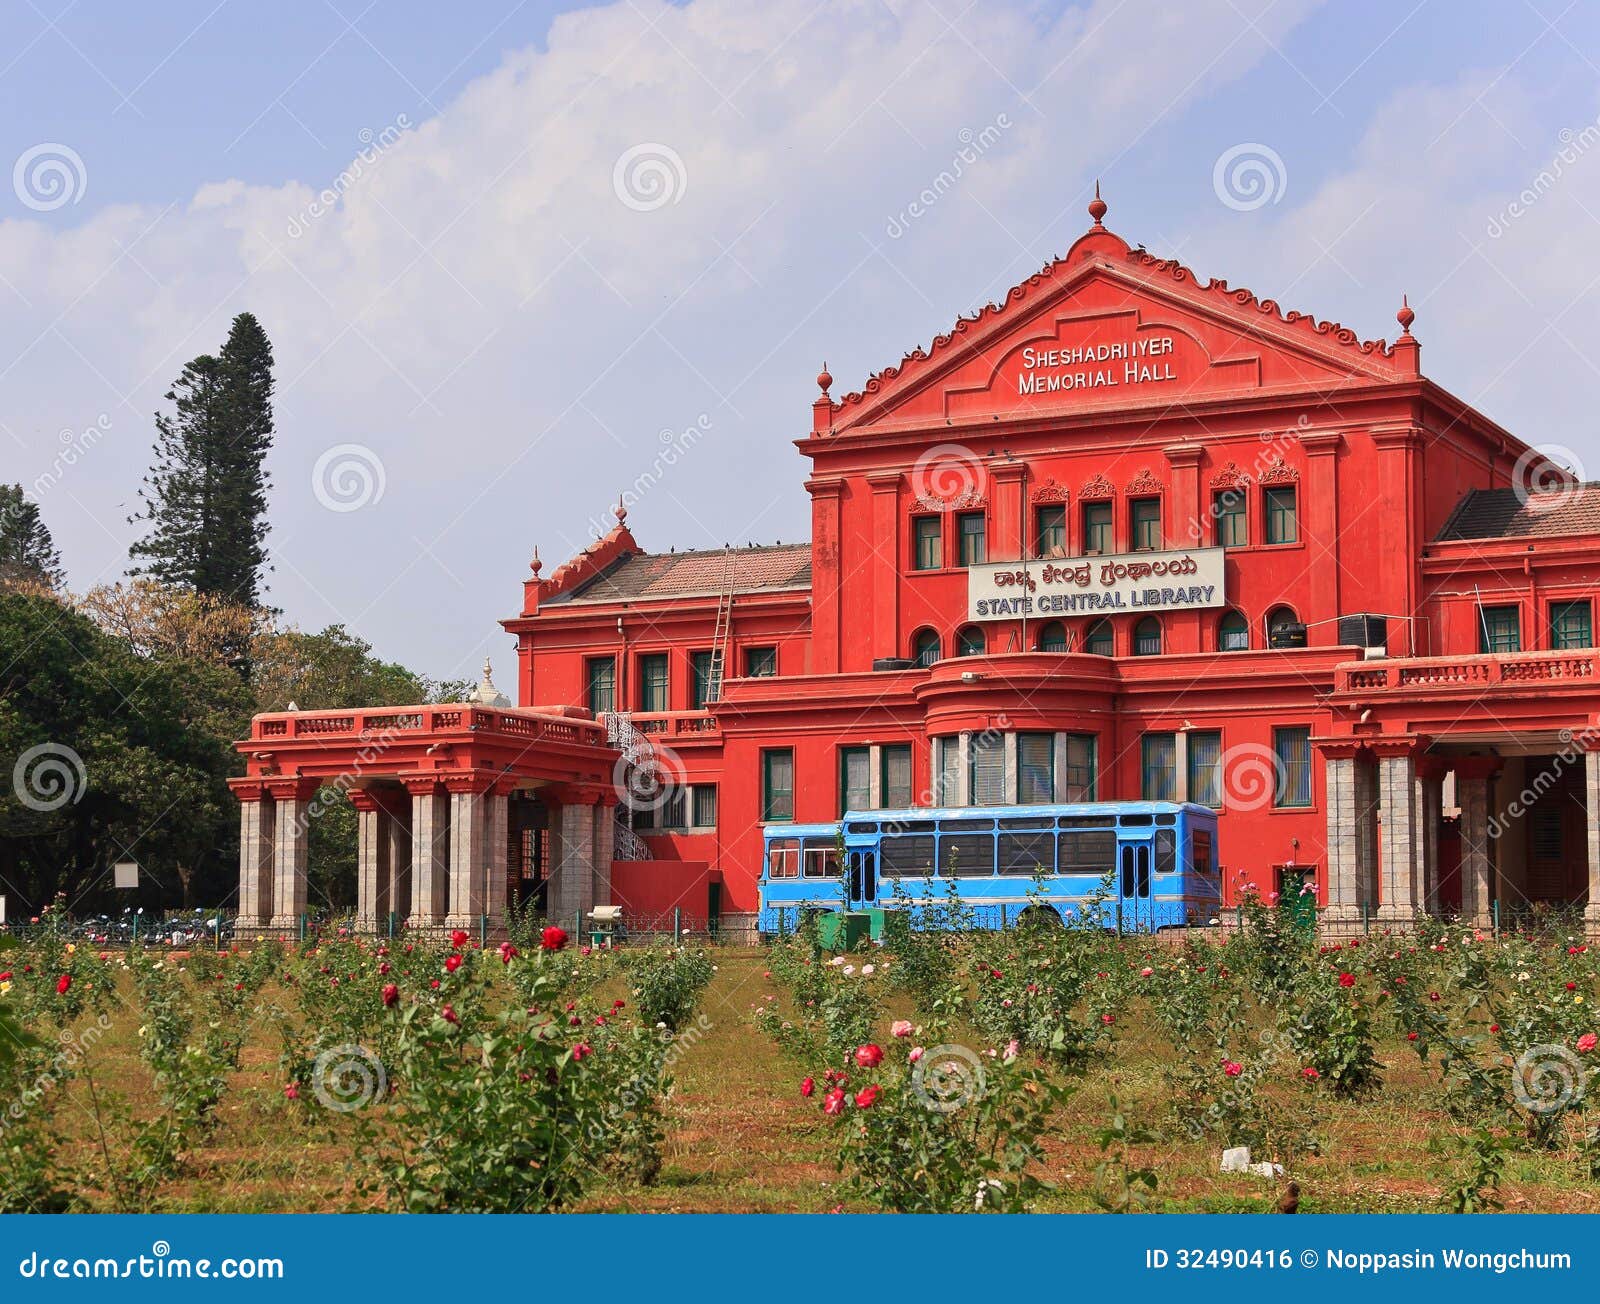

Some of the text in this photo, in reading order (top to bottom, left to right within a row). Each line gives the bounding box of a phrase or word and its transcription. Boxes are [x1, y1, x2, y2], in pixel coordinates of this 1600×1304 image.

[1018, 360, 1177, 395] MEMORIAL HALL
[993, 554, 1199, 593] ರಾಜ್ಯ ಕೇಂದ್ರ ಗ್ರಂಥಾಲಯ
[976, 585, 1216, 616] STATE CENTRAL LIBRARY
